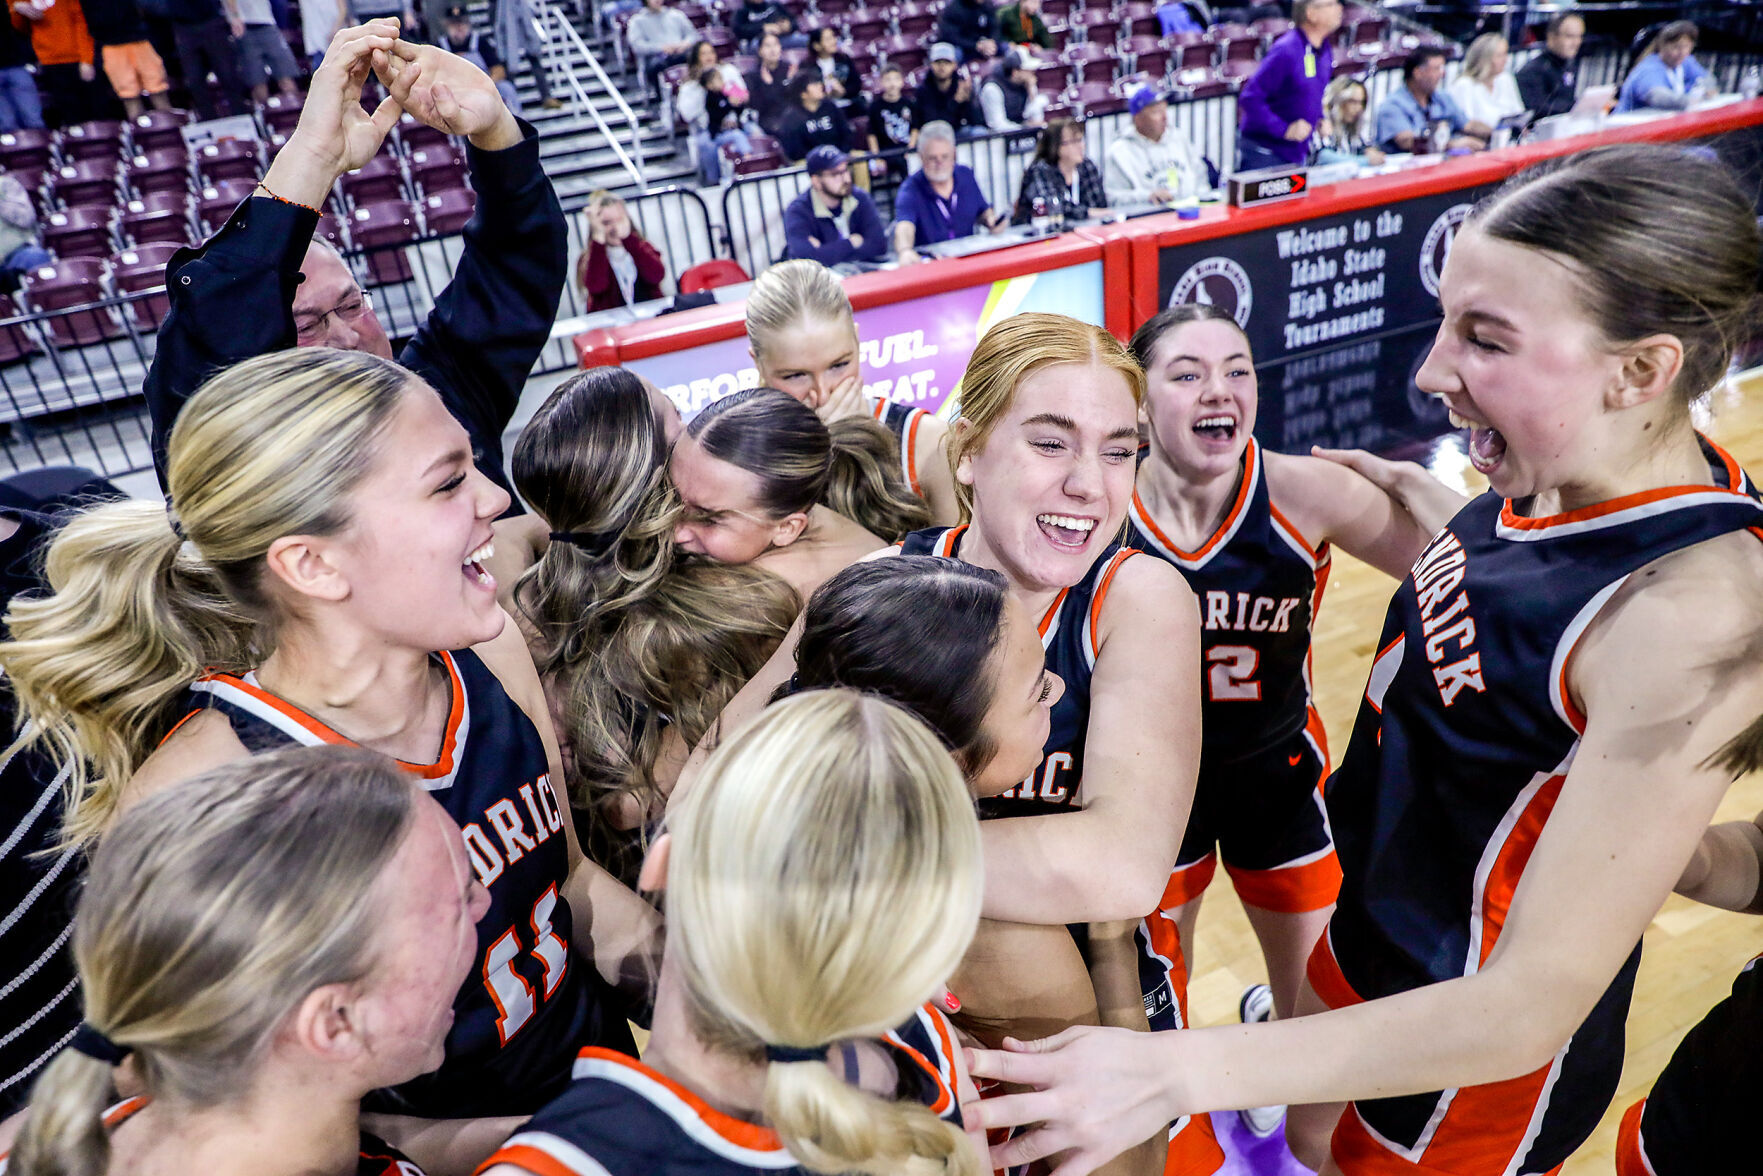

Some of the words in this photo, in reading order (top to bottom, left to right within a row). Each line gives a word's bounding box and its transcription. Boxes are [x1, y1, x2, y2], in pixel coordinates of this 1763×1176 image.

[1276, 226, 1348, 259] Welcome
[1354, 219, 1371, 243] to
[1376, 210, 1403, 238] the
[1290, 255, 1338, 288] Idaho
[1343, 247, 1386, 276] State
[1287, 286, 1327, 320] High
[1333, 272, 1385, 308] School
[1283, 306, 1385, 350] Tournaments
[1194, 590, 1301, 633] RICK
[1205, 644, 1262, 702] 2
[462, 772, 564, 888] DRIC
[483, 880, 568, 1049] 11
